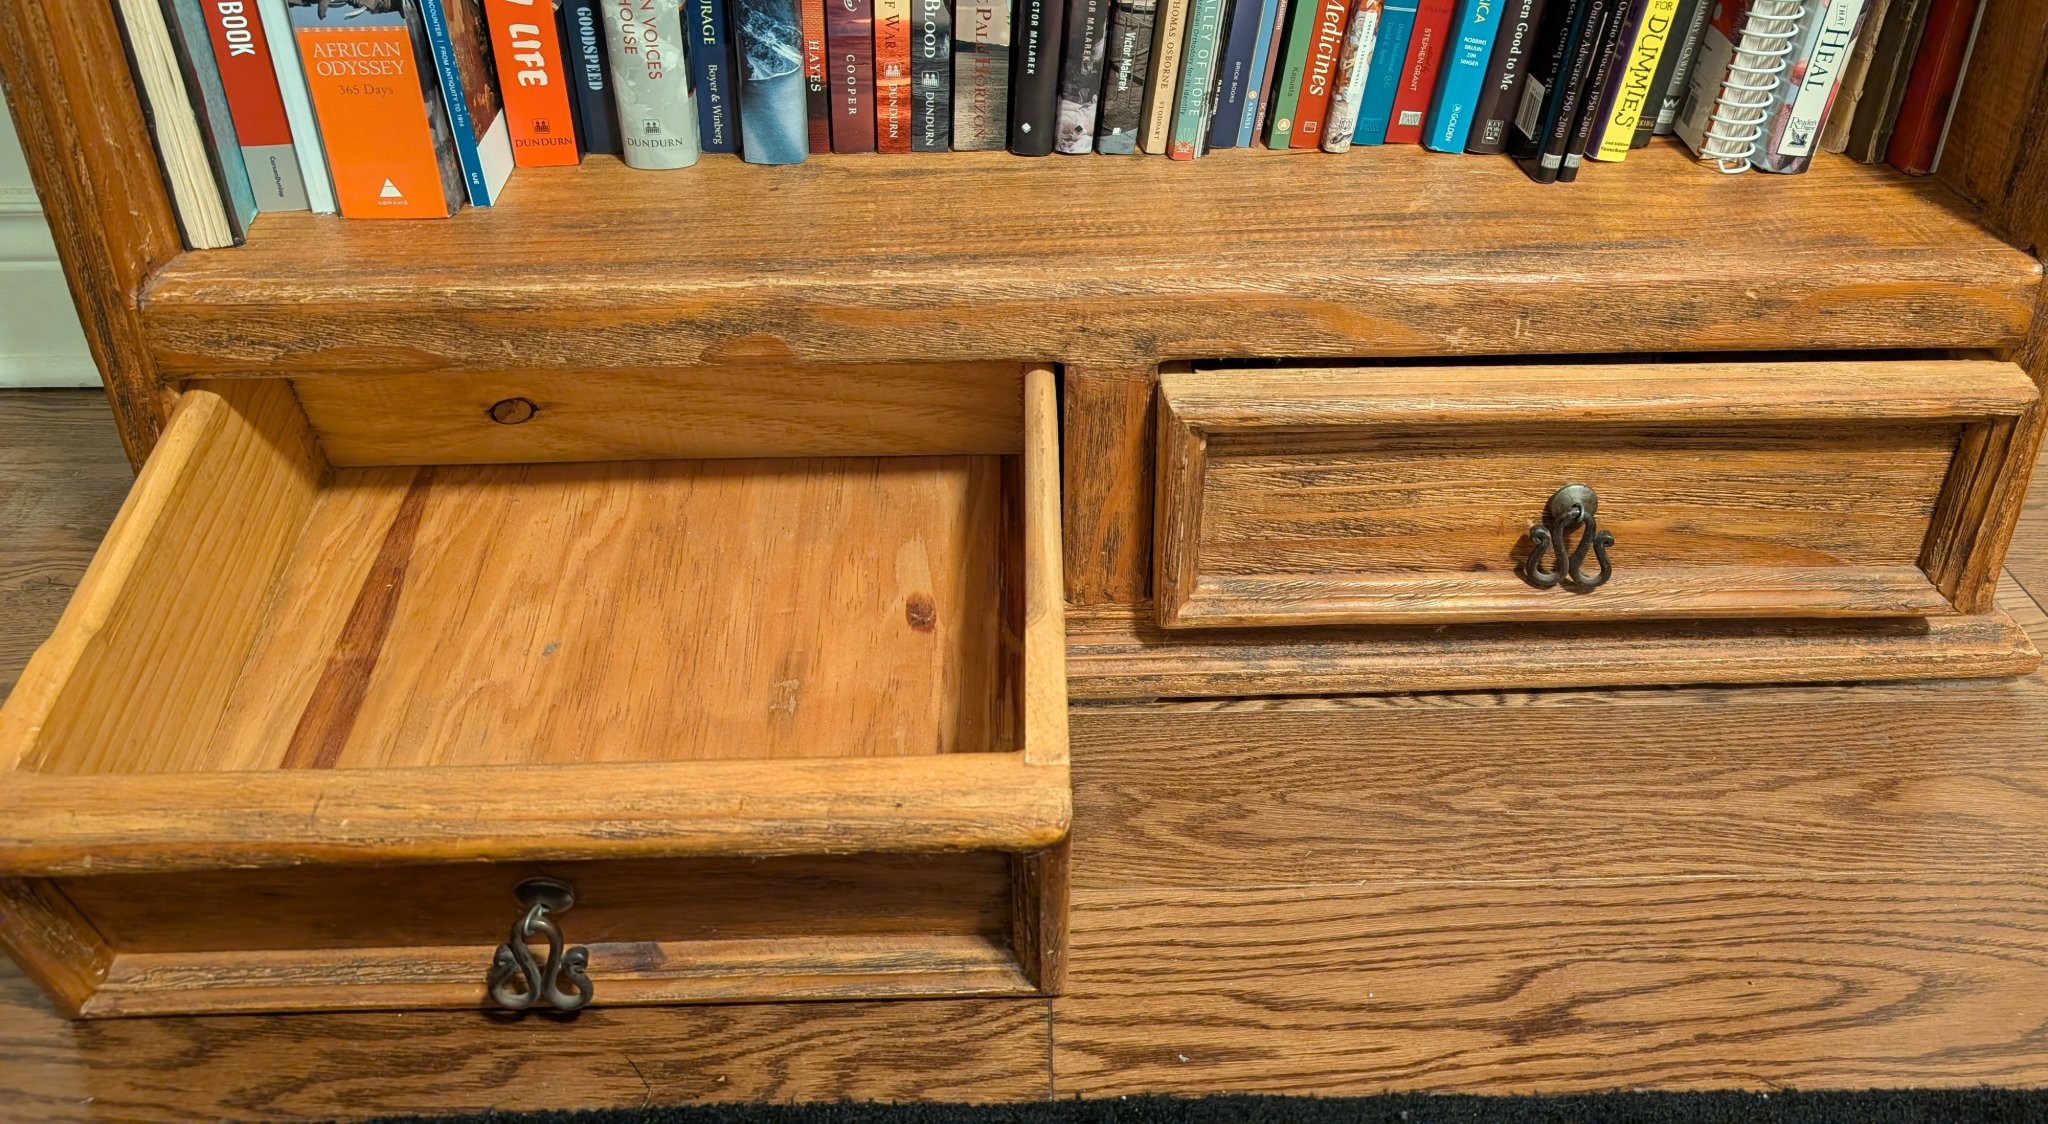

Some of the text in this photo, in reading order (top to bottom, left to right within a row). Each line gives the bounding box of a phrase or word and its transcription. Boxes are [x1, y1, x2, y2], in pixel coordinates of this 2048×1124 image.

[1584, 1, 1603, 38] Ontario
[1609, 1, 1628, 38] Ontario
[1655, 1, 1674, 10] FOR
[1837, 4, 1847, 26] THAT
[217, 1, 256, 56] BOOK
[643, 17, 663, 80] VOICES
[885, 14, 900, 49] WAR
[924, 0, 941, 58] BLOOD
[1083, 17, 1095, 61] MALAREK
[1189, 31, 1200, 66] Orthodoxy
[1464, 36, 1487, 45] ROBBINS
[1511, 21, 1529, 55] Good
[1673, 0, 1709, 86] HARRY BECKWITH
[313, 41, 402, 58] AFRICAN
[316, 60, 405, 76] ODYSSEY
[509, 24, 549, 87] LIFE
[576, 7, 604, 91] GOODSPEED
[808, 40, 822, 92] HAYES
[1027, 30, 1038, 75] MALAREK
[1117, 32, 1136, 92] Victor Malarek
[1161, 42, 1175, 89] OSBORNE
[1197, 49, 1208, 68] OF
[1410, 27, 1432, 91] STEPHEN GRANT
[1460, 59, 1479, 67] SINGER
[1507, 56, 1516, 70] to
[1568, 39, 1590, 88] Advocates,
[1593, 39, 1615, 88] Advocates,
[1804, 27, 1850, 92] HEAL
[339, 83, 394, 97] 365 Days
[440, 46, 450, 66] FROM
[445, 67, 460, 103] ANTIQUITY
[454, 102, 461, 113] TO
[846, 54, 857, 115] COOPER
[1229, 61, 1242, 104] BRICK BOOKS
[1287, 66, 1299, 97] Kapusta
[1500, 72, 1516, 91] Me
[1614, 15, 1669, 127] DUMMIES
[707, 64, 723, 145] Boyer & Winberg
[888, 84, 899, 139] DUNDURN
[973, 58, 992, 138] HORIZON
[1180, 89, 1190, 115] Identity
[1189, 76, 1205, 117] HOPE
[1244, 102, 1255, 129] ANANSI
[1256, 102, 1266, 131] DC BOOKS
[925, 92, 935, 147] DUNDURN
[1154, 101, 1165, 140] STODDART
[1445, 111, 1459, 142] GOLDEN
[514, 136, 574, 149] DUNDURN
[627, 138, 683, 148] DUNDURN
[471, 172, 480, 185] UJE
